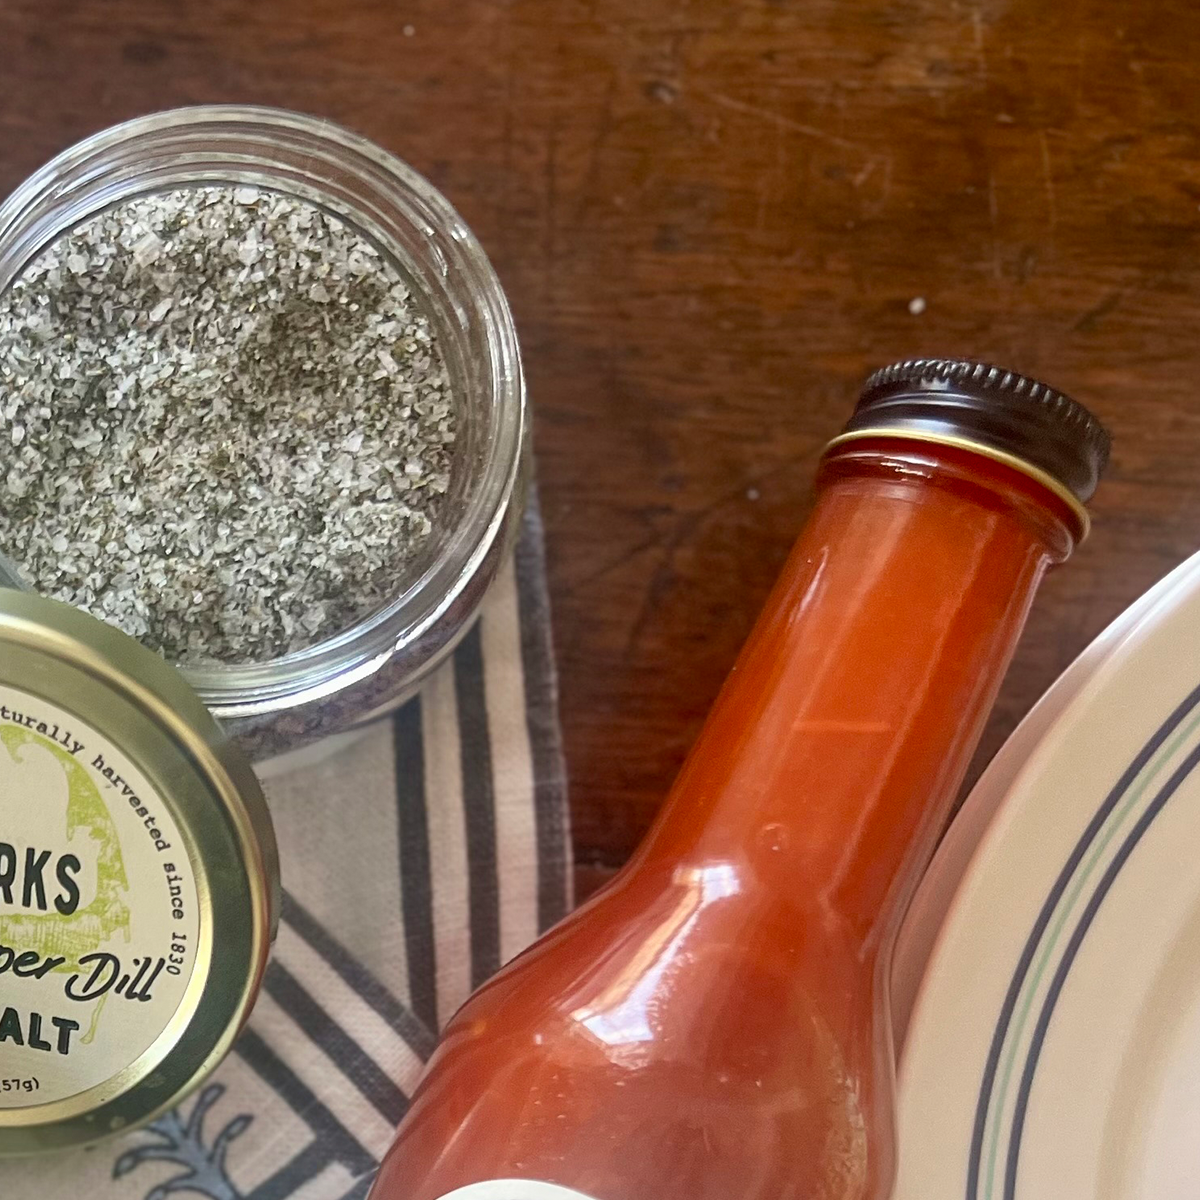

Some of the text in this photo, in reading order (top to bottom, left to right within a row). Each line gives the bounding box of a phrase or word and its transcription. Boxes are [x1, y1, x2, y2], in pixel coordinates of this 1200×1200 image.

[91, 754, 171, 852] harvested
[163, 862, 184, 920] since
[65, 953, 165, 1002] Dill
[166, 932, 186, 975] 1830
